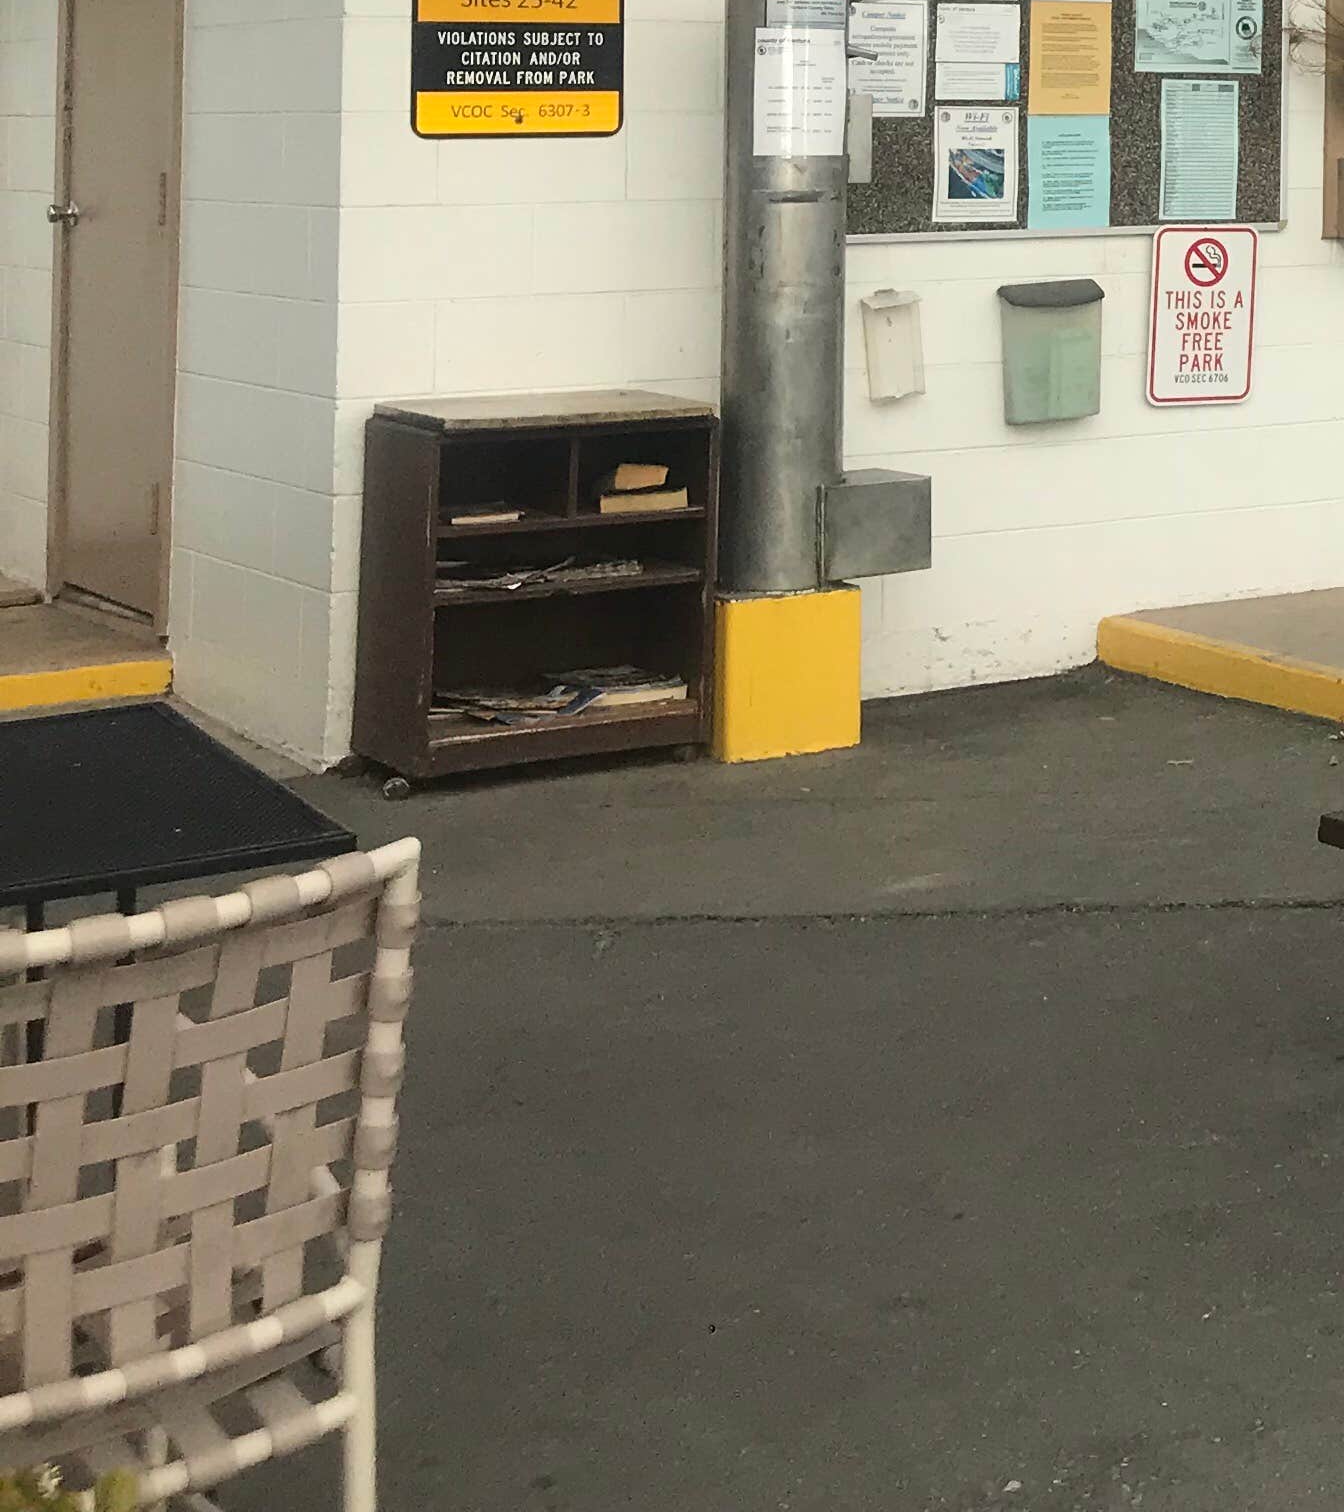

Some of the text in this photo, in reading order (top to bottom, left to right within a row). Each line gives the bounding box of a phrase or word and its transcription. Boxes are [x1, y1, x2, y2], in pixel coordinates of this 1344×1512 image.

[438, 32, 604, 46] VIOLATIONS SUBJECT TO
[461, 52, 581, 65] CITATION AND/OR
[446, 71, 595, 85] REMOVAL FROM PARK
[451, 105, 493, 118] VCOC
[538, 104, 591, 117] 6307-3
[1165, 290, 1244, 309] THIS IS A
[1175, 312, 1232, 330] SMOKE
[1181, 332, 1224, 351] FREE
[1179, 353, 1224, 372] PARK
